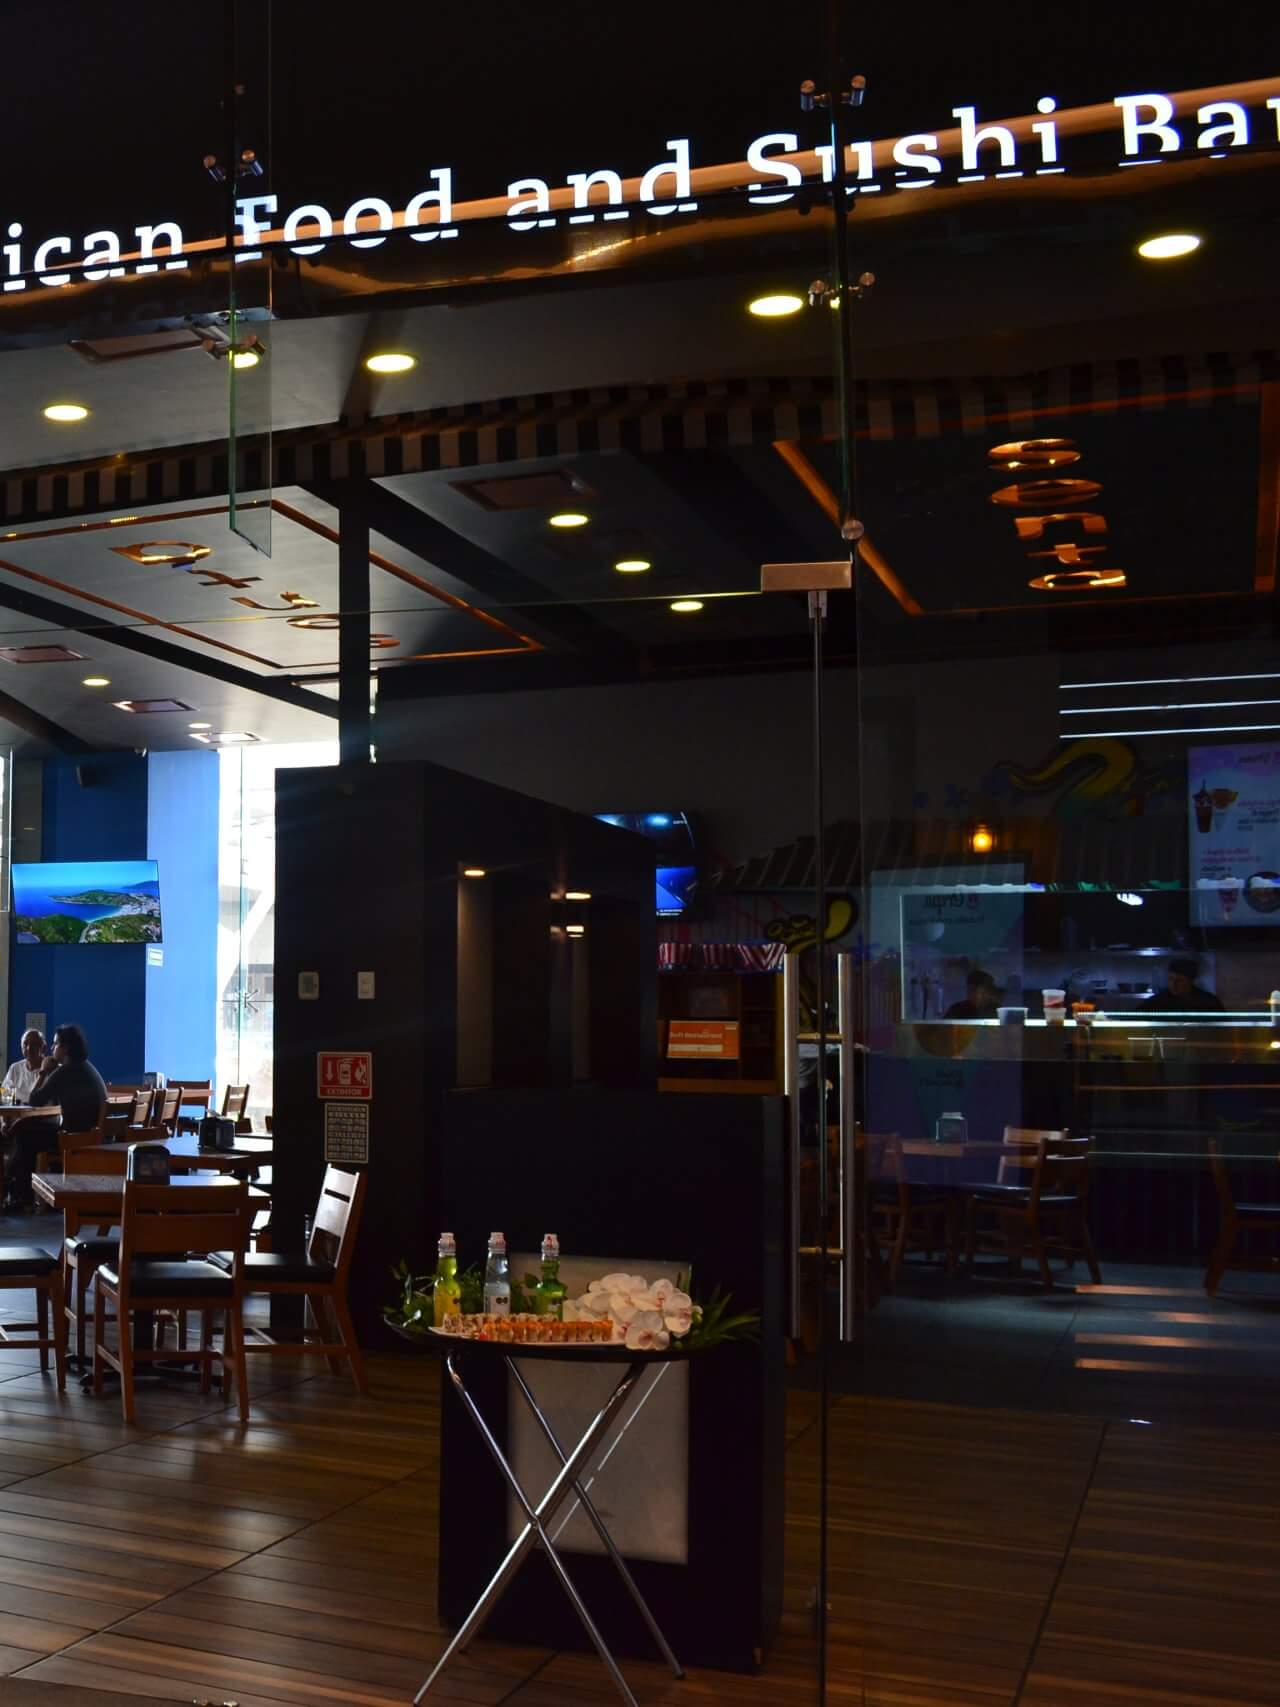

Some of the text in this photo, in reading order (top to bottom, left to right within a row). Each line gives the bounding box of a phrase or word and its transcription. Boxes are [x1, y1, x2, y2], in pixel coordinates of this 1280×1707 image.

[234, 164, 460, 262] Food
[504, 138, 700, 231] and
[746, 94, 1068, 205] Sushi
